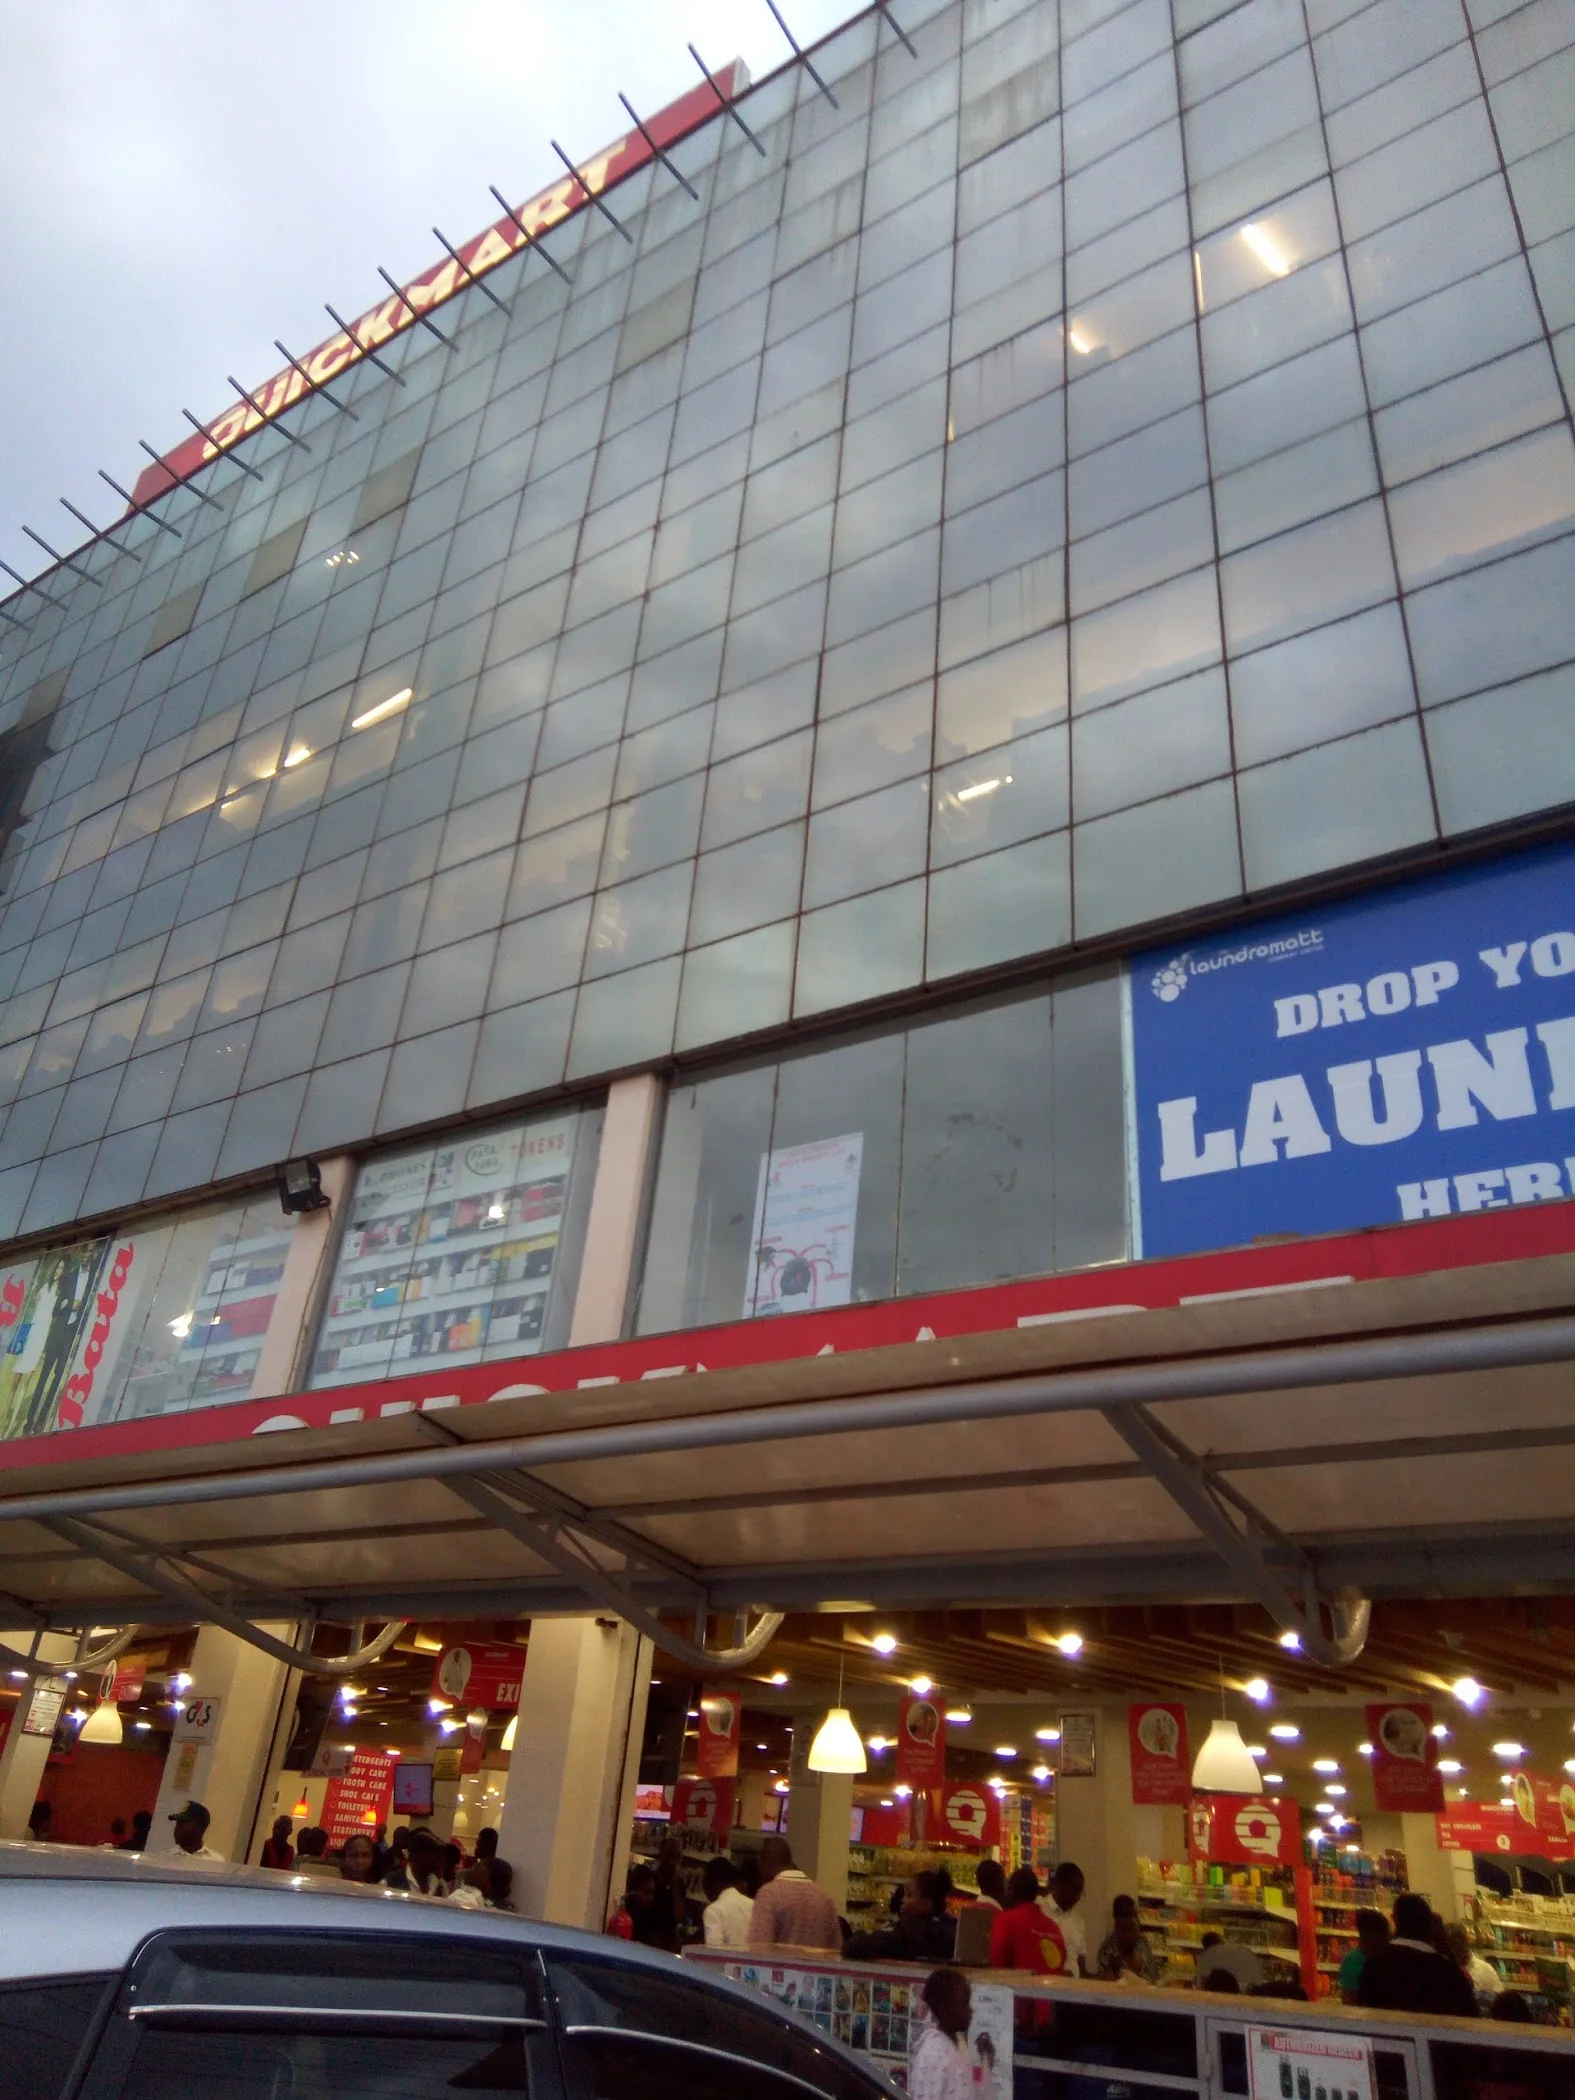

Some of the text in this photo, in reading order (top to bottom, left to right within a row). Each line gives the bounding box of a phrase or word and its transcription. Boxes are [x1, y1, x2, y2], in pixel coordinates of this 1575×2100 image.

[202, 137, 628, 461] QUICKMART
[1273, 931, 1575, 1039] DROP YO
[1397, 1155, 1575, 1221] HER
[496, 1683, 520, 1702] EXI
[354, 1755, 392, 1767] ETERGENTS
[351, 1767, 366, 1776] ODY
[368, 1768, 387, 1779] CARE
[343, 1777, 387, 1791] TOOTH CARE
[340, 1789, 358, 1799] SHOE
